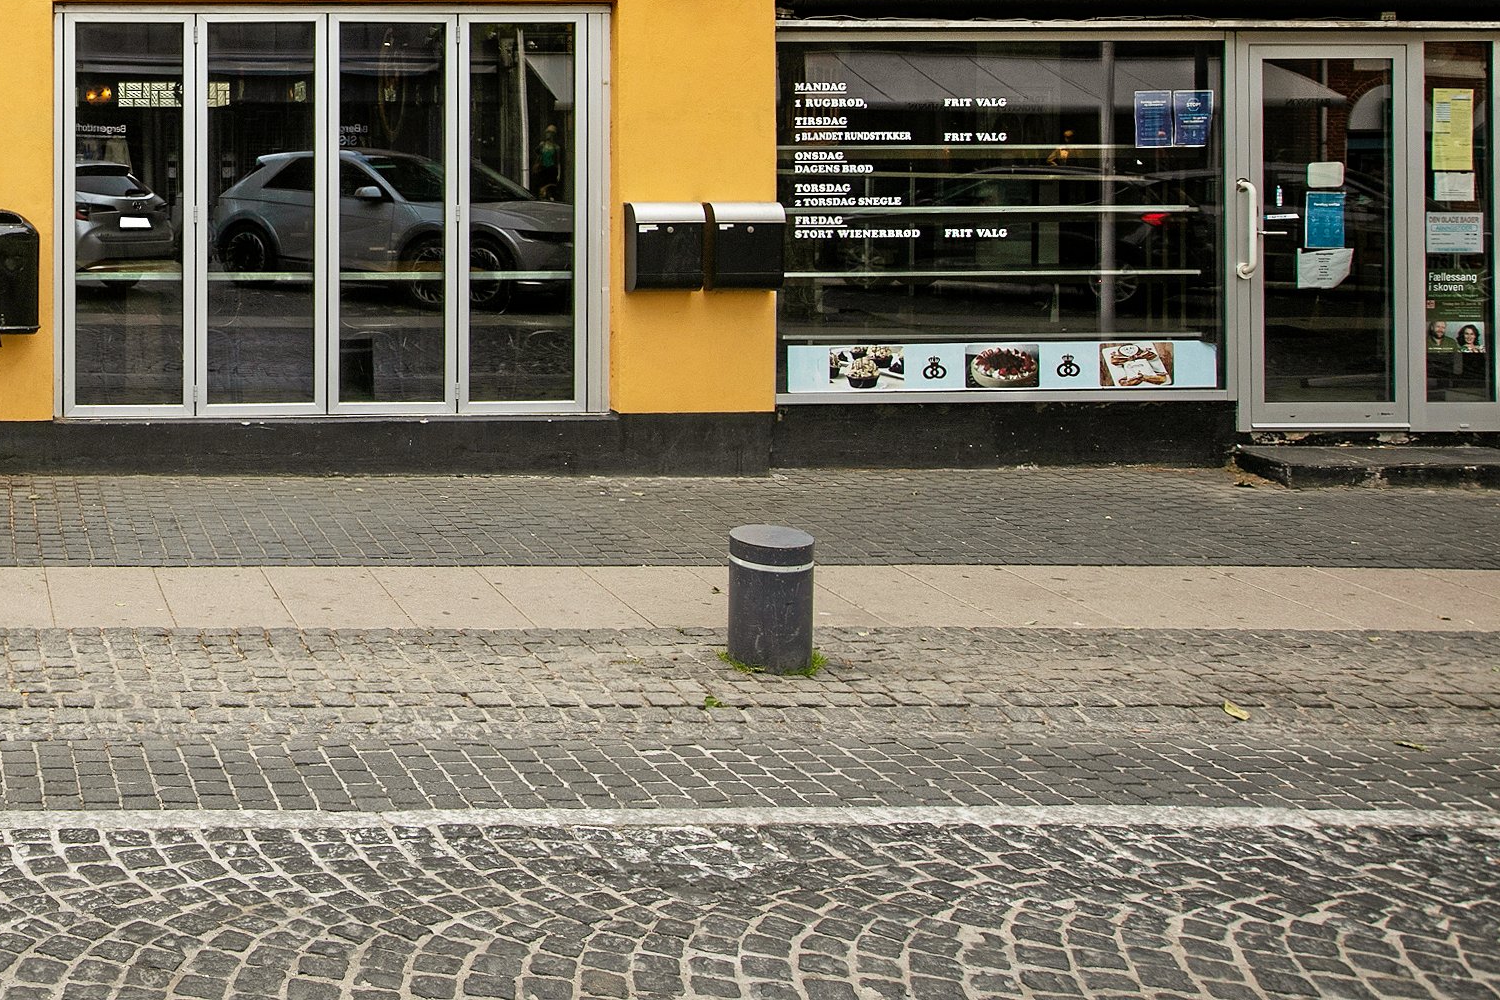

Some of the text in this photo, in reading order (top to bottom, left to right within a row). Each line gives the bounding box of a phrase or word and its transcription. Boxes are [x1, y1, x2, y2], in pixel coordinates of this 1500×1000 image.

[794, 82, 847, 92] MANDAG
[806, 98, 868, 108] RUGBRØD,
[944, 98, 972, 106] FRIT
[976, 98, 1007, 106] VALG
[794, 117, 848, 126] TIRSDAG
[802, 132, 844, 140] BLANDET
[844, 131, 912, 140] RUNDSTYKKER
[944, 133, 972, 142] FRIT
[976, 133, 1008, 142] VALG
[794, 152, 844, 160] ONSDAG
[794, 164, 874, 174] DAGENS BRØD
[794, 184, 851, 192] TORSDAG
[803, 198, 856, 206] TORSDAG
[858, 196, 902, 206] SNEGLE
[794, 216, 843, 224] FREDAG
[794, 229, 1008, 238] STORT WIENERBRØD FRIT VALG
[1428, 272, 1477, 284] Fællessang
[1433, 283, 1464, 292] skoven
